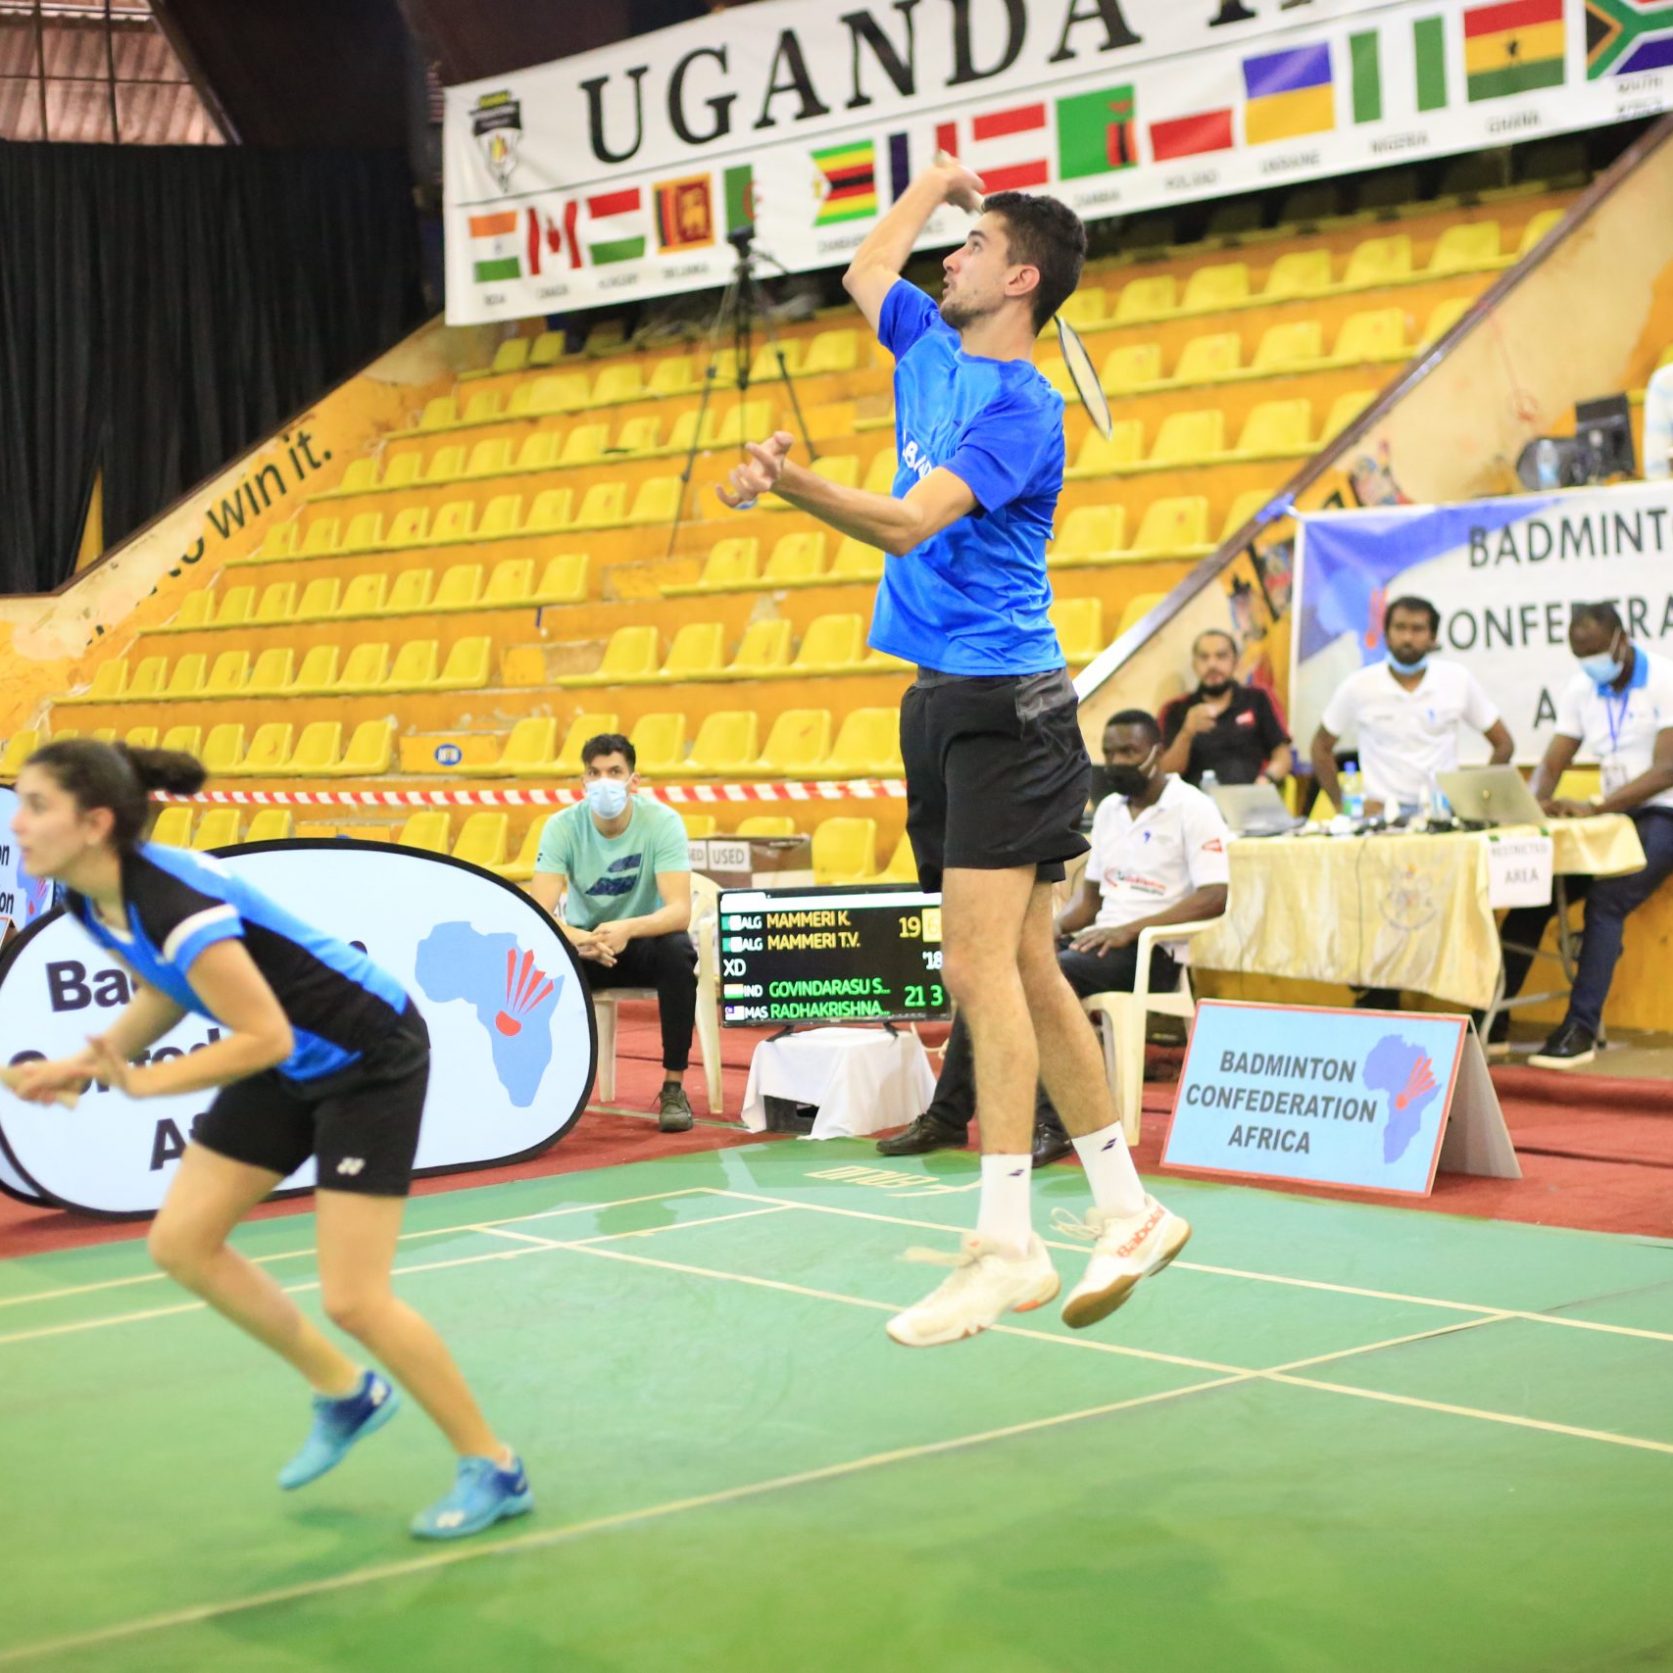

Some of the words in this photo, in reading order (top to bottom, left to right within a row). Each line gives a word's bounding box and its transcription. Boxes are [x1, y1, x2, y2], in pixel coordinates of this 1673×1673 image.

[579, 0, 1143, 164] UGANDA
[207, 463, 287, 540] win
[283, 430, 333, 481] it.
[1469, 507, 1673, 568] BADMINT
[712, 848, 745, 865] USED
[740, 915, 762, 930] ALG
[766, 911, 835, 929] MAMMERI
[838, 910, 852, 927] K.
[898, 916, 922, 938] 19
[741, 937, 764, 951] ALG
[767, 933, 836, 950] MAMMERI
[838, 931, 861, 948] T.V.
[723, 958, 747, 977] XD
[743, 984, 763, 998] IND
[769, 979, 870, 998] GOVINDARASU
[904, 985, 926, 1007] 21
[930, 984, 943, 1007] 3
[744, 1006, 768, 1019] MAS
[1219, 1050, 1357, 1083] BADMINTON
[1185, 1083, 1378, 1123] CONFEDERATION
[1227, 1124, 1311, 1154] AFRICA
